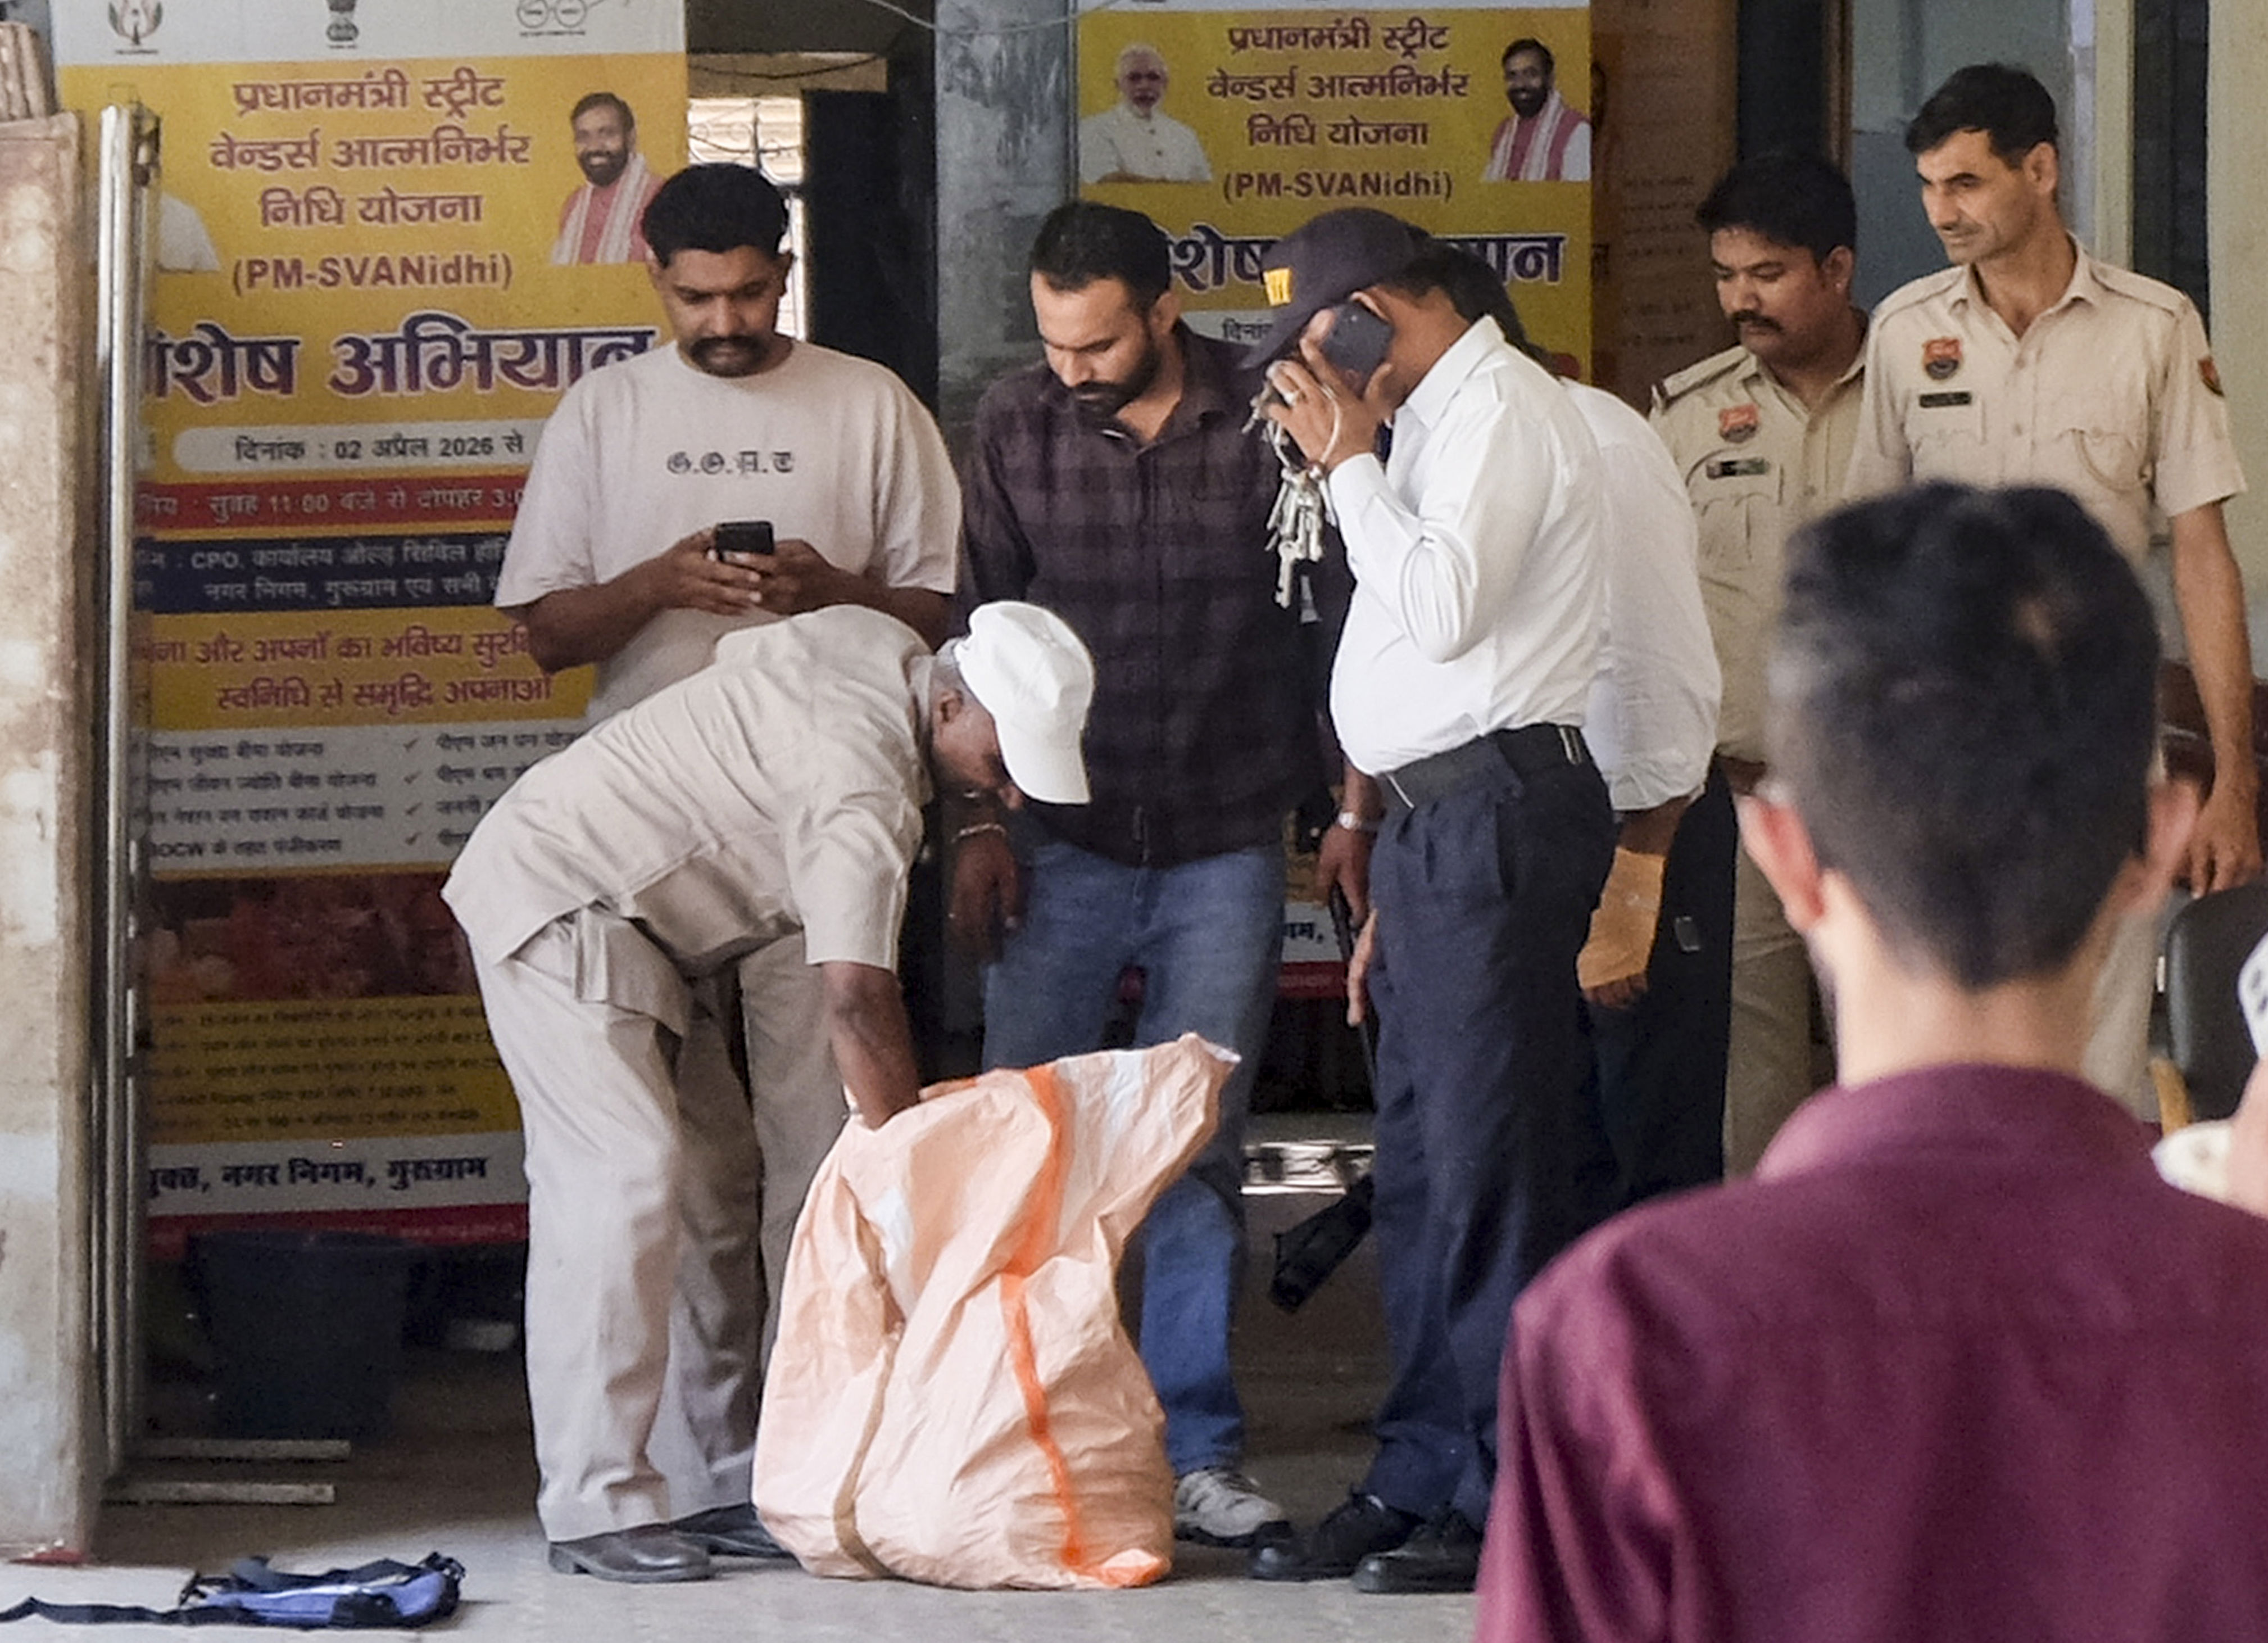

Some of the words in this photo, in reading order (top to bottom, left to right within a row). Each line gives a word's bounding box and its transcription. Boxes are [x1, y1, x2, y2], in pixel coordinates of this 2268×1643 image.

[1227, 17, 1371, 54] प्रधानमंत्री
[1382, 16, 1450, 59] स्ट्रीट
[232, 68, 409, 117] प्रधानमंत्री
[422, 67, 506, 117] स्ट्रीट
[1206, 66, 1298, 100] वेन्डर्स
[1307, 64, 1471, 97] आत्मनिर्भर
[210, 128, 320, 170] वेन्डर्स
[332, 124, 530, 167] आत्मनिर्भर
[1247, 114, 1316, 146] निधि
[1327, 115, 1428, 144] योजना
[260, 187, 345, 226] निधि
[358, 186, 483, 224] योजना
[1223, 170, 1453, 205] (PM-SVANidhi)
[232, 252, 512, 296] (PM-SVANidhi)
[1173, 224, 1281, 290] शेष
[235, 436, 305, 461] दिनांक
[335, 441, 362, 460] 02
[439, 437, 494, 457] 2026
[338, 637, 371, 657] का
